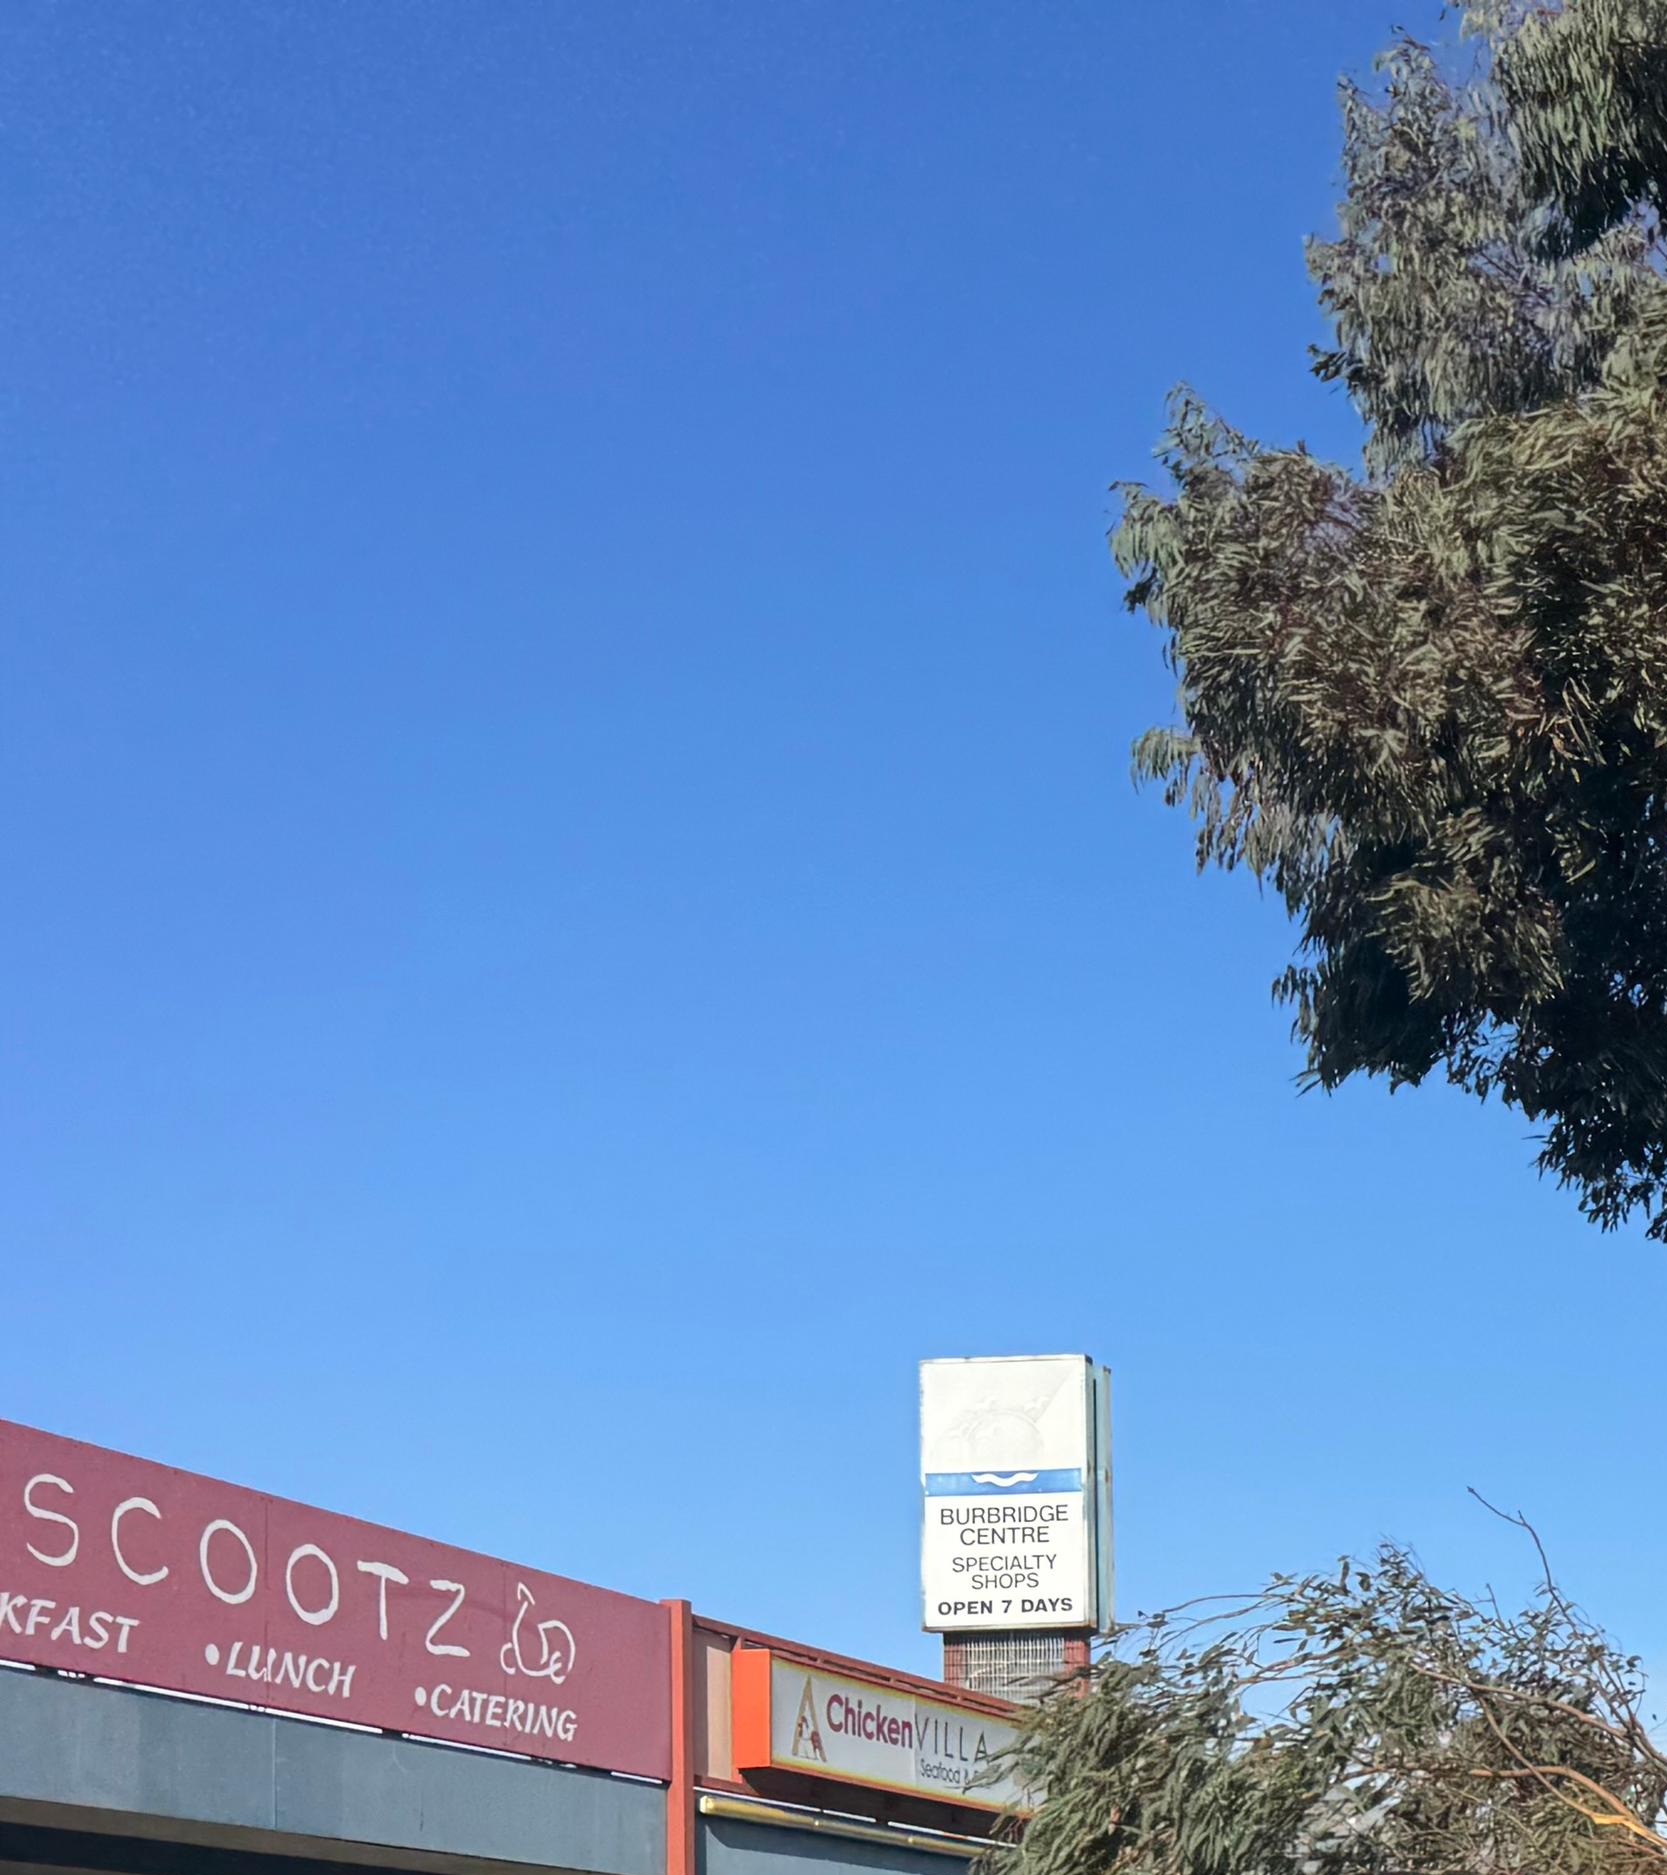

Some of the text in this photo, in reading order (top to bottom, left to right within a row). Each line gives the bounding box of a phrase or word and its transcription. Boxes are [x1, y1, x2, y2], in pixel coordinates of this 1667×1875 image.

[940, 1504, 1069, 1526] BURBRIDGE
[959, 1526, 1050, 1546] CENTRE
[24, 1473, 470, 1657] SCOOTZ
[952, 1554, 1057, 1573] SPECIALTY
[971, 1572, 1039, 1590] SHOPS
[938, 1597, 1073, 1616] OPEN 7 DAYS
[826, 1693, 988, 1763] Chicken VILLA
[920, 1758, 960, 1784] Seafood
